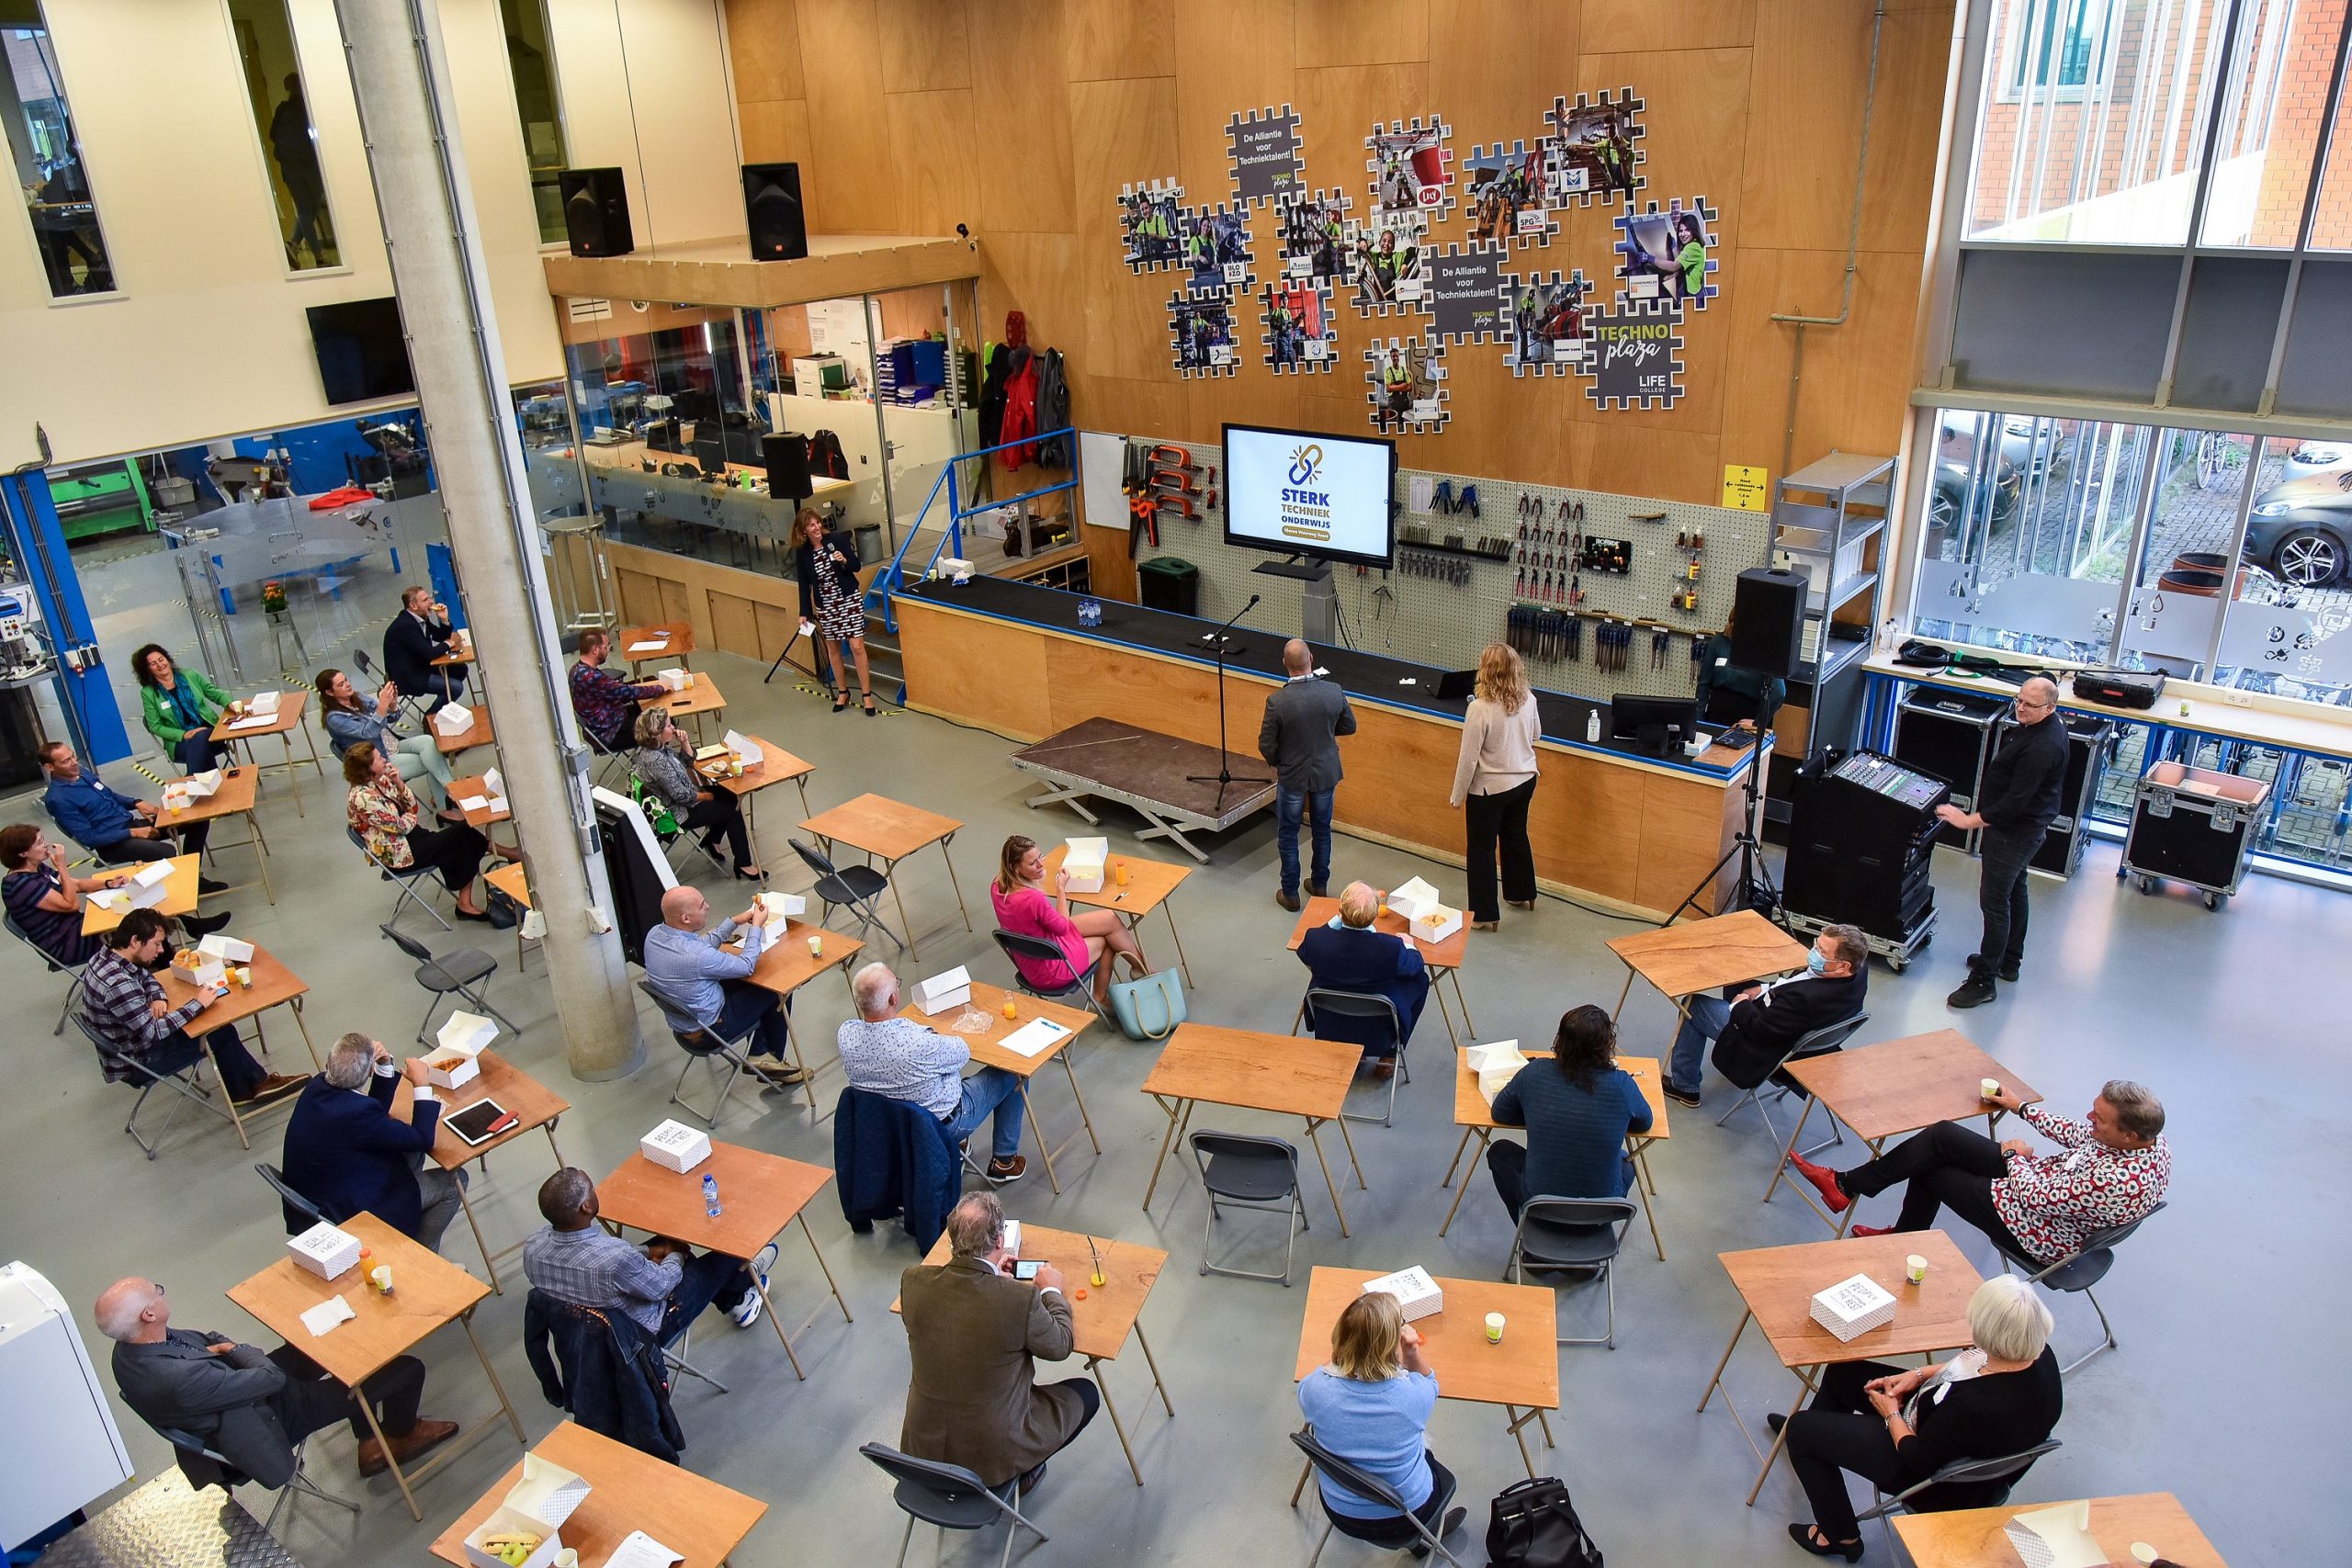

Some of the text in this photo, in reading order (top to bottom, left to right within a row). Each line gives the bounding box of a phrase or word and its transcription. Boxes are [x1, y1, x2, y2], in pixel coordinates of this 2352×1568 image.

[1243, 130, 1283, 143] De Alliantie
[1256, 143, 1272, 152] voor
[1239, 150, 1291, 165] Techniektalent!
[1520, 218, 1534, 226] SPG
[1442, 265, 1487, 276] De Alliantie
[1456, 279, 1475, 288] voor
[1436, 288, 1496, 300] Techniektalent!
[1475, 315, 1493, 327] plaza
[1598, 324, 1668, 341] TECHNO
[1604, 333, 1661, 369] plaza
[1639, 375, 1666, 387] LIFE
[1281, 488, 1330, 507] STERK
[1281, 503, 1330, 518] TECHNIEK
[1281, 515, 1330, 529] ONDERWIJS
[272, 613, 282, 624] 1
